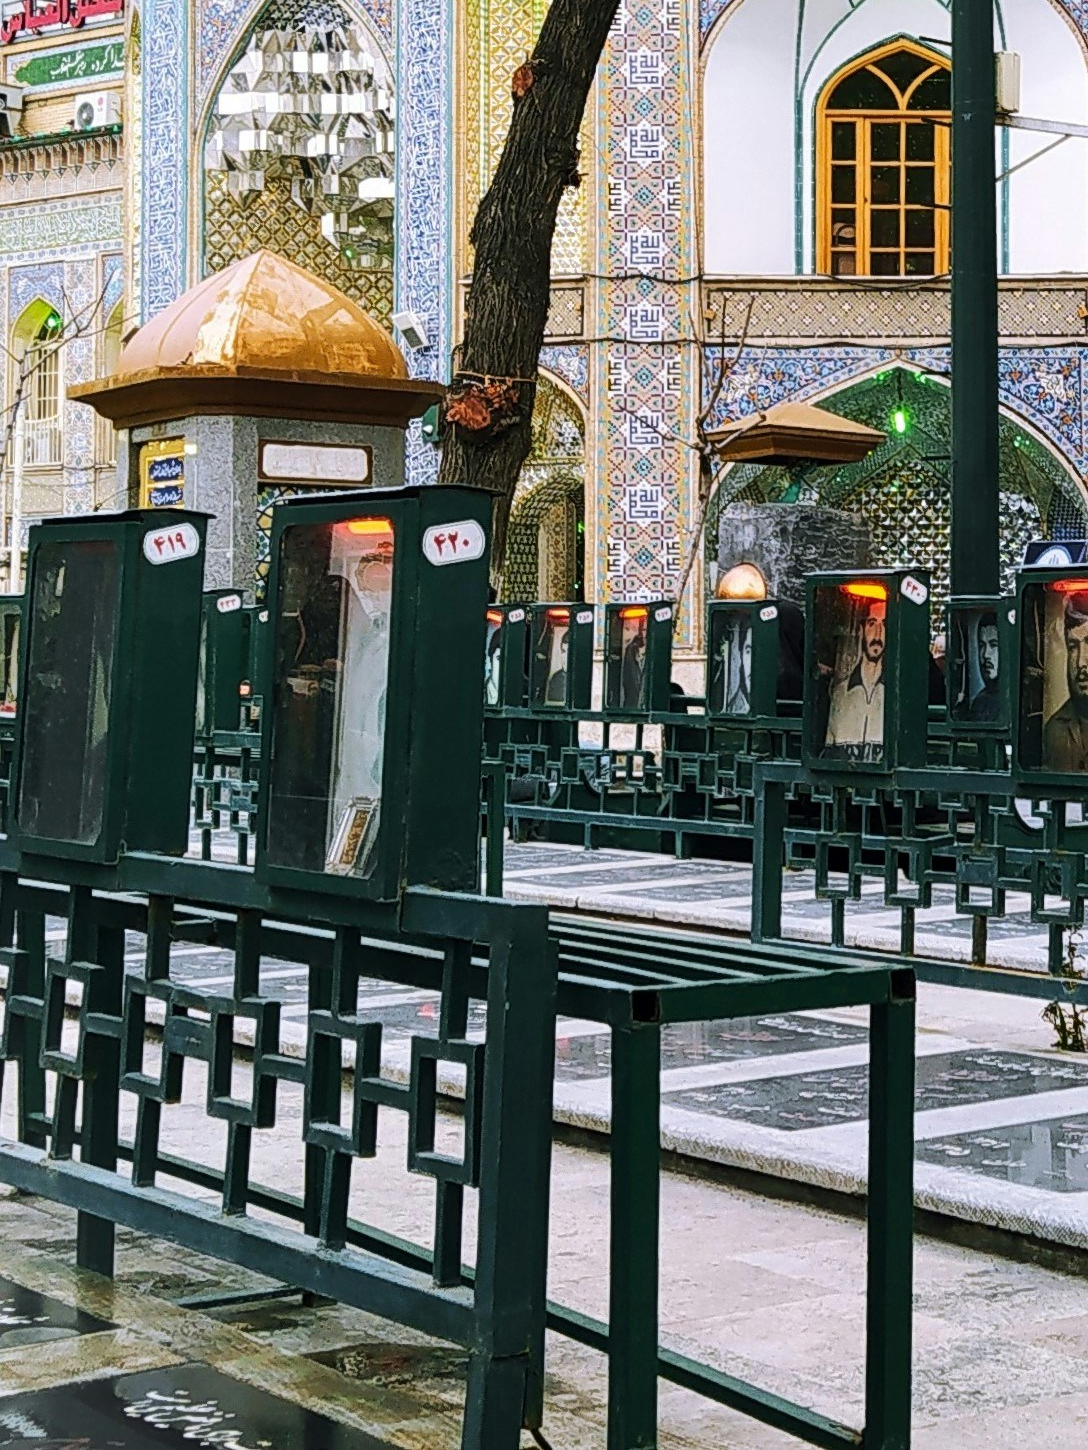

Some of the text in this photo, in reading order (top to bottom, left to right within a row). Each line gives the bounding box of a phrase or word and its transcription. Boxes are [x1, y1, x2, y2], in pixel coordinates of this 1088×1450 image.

[153, 531, 187, 556] ۴۱۹
[432, 530, 470, 555] ۴۲۰
[904, 580, 922, 598] ۴۳۰
